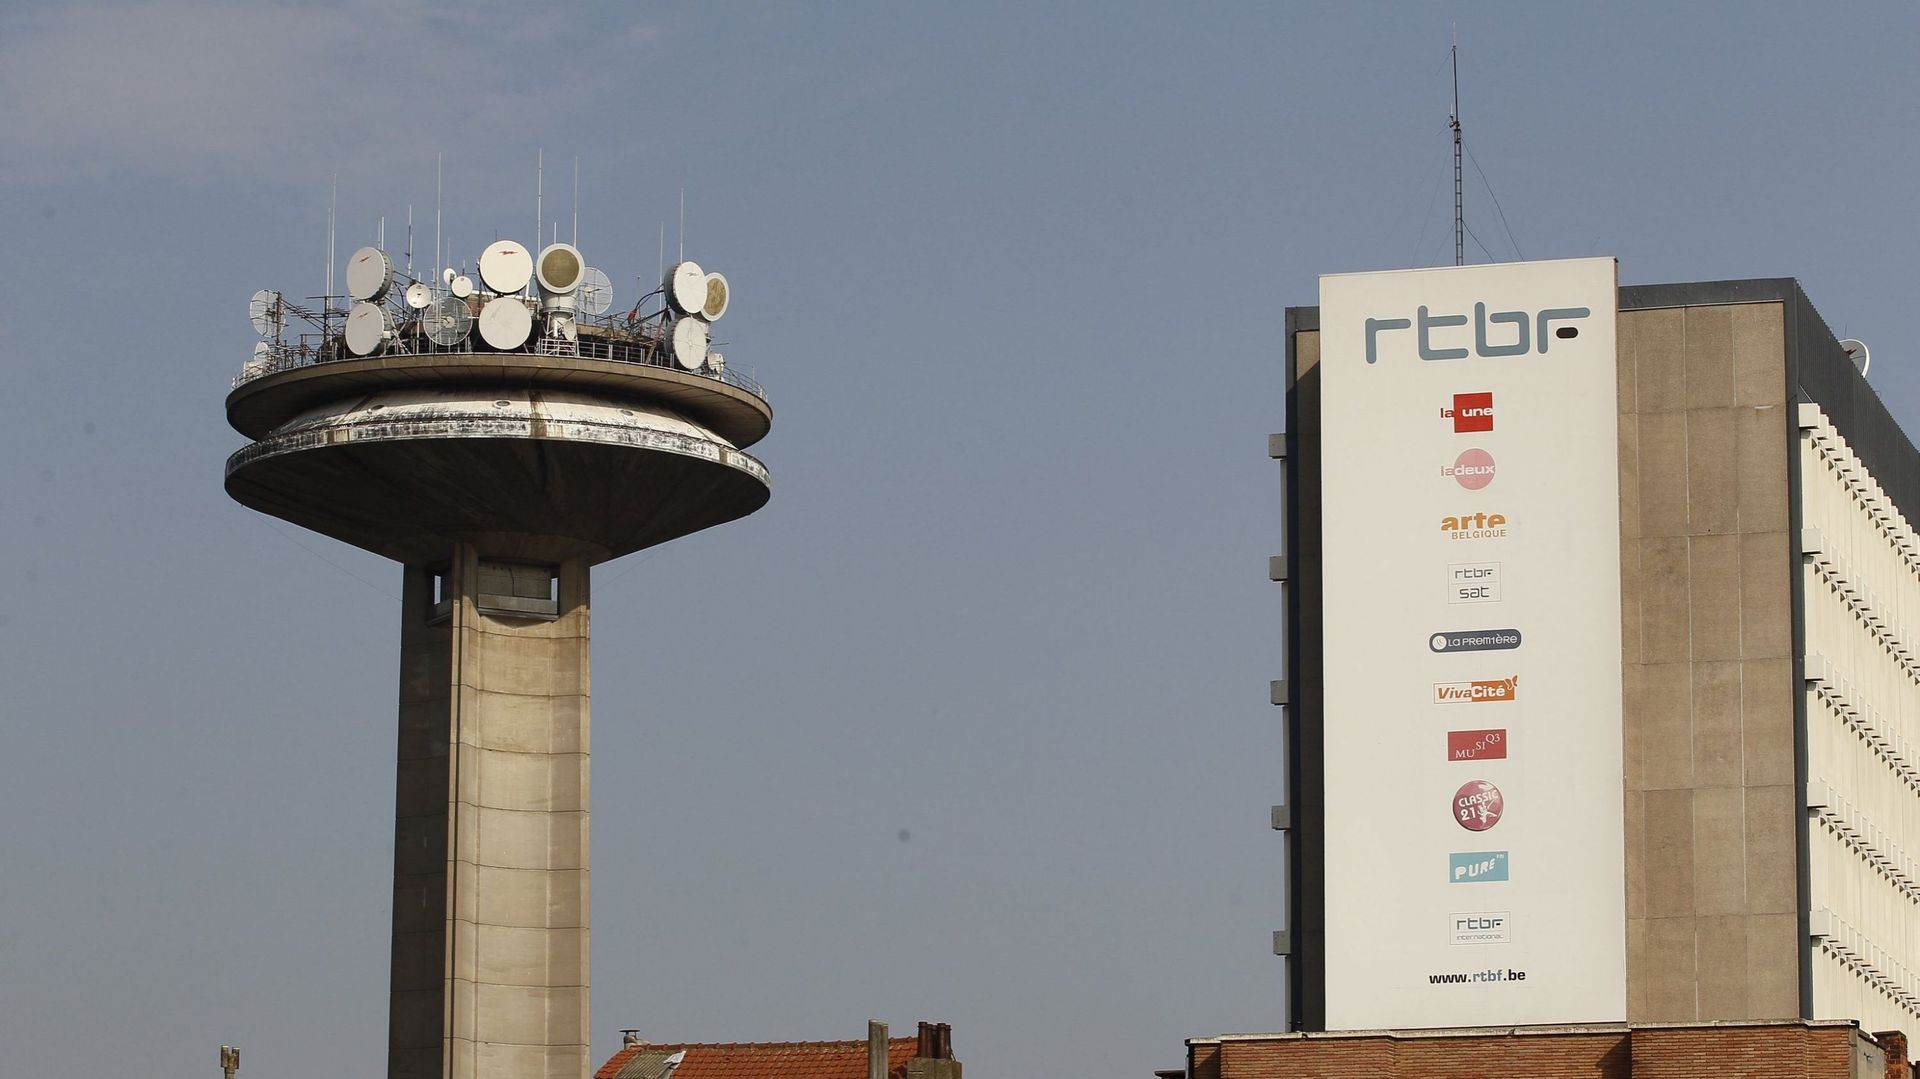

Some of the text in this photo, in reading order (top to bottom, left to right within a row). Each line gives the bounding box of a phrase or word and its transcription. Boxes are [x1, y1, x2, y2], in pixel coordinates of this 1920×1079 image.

[1440, 406, 1493, 418] la une
[1441, 512, 1506, 531] arte
[1452, 529, 1507, 540] BELGIQUE
[1459, 586, 1490, 599] sat
[1438, 685, 1505, 699] VivaCité
[1458, 789, 1499, 807] CLASSIC
[1460, 807, 1476, 821] 21
[1454, 858, 1496, 880] PURE
[1457, 933, 1503, 941] international
[1429, 969, 1526, 984] www.rtbf.be
